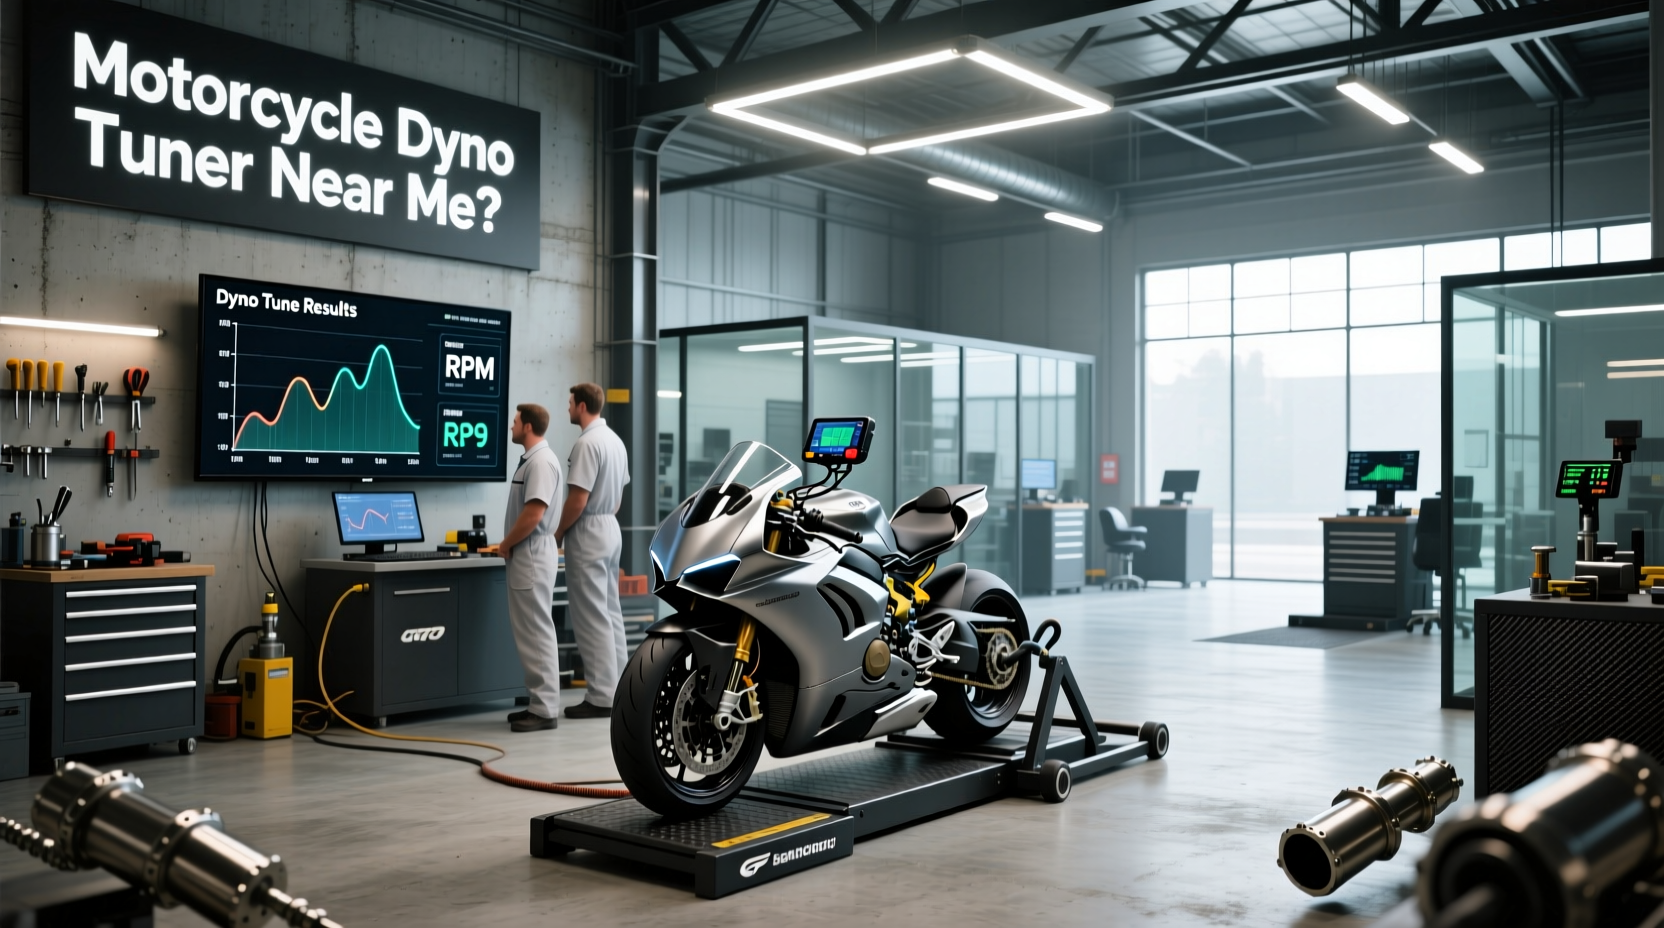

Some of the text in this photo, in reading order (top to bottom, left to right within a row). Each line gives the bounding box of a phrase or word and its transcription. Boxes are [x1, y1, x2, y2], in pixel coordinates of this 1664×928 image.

[74, 31, 515, 177] Motorcycle Dyno
[74, 106, 502, 234] Tuner Near Me?
[216, 288, 358, 318] Dyno Tune Results
[445, 353, 495, 381] RPM
[443, 421, 489, 448] RP9
